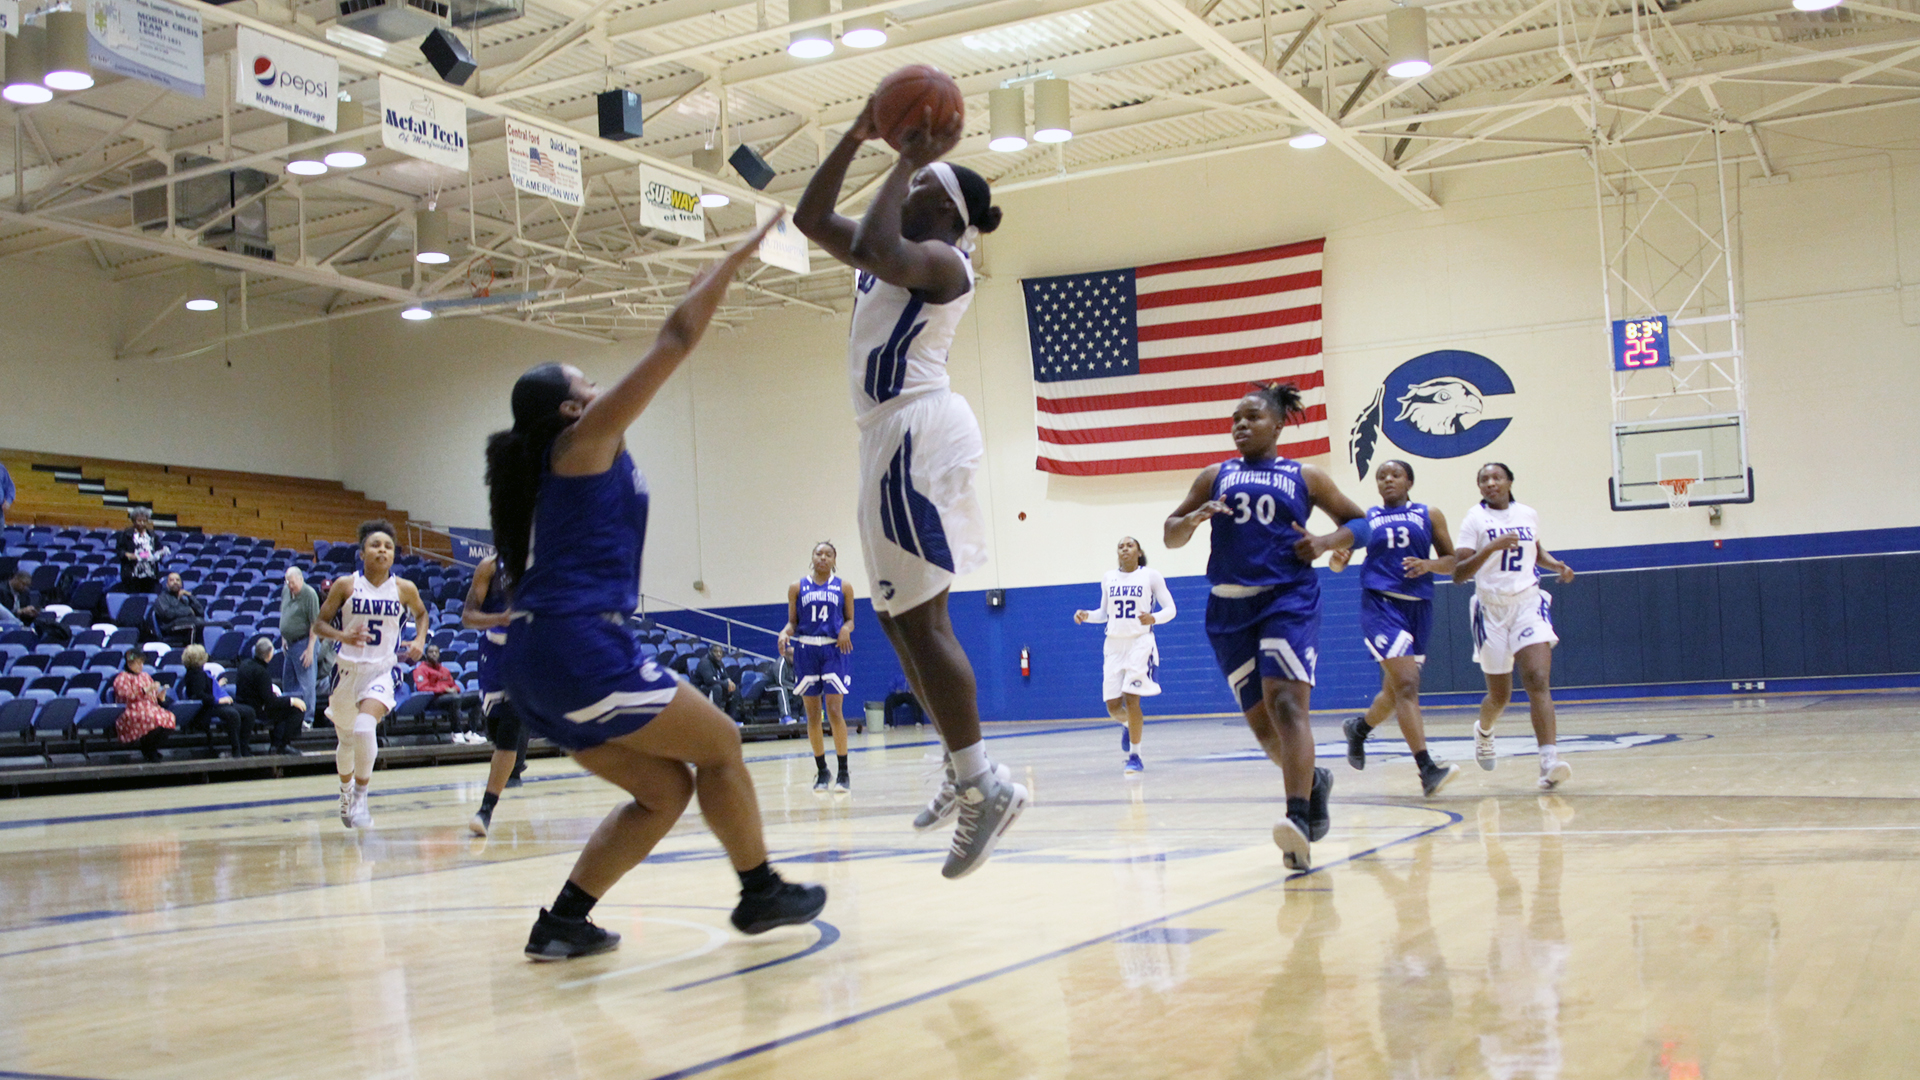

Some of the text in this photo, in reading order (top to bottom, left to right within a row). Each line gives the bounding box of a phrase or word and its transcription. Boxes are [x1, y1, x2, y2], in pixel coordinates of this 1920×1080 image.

[138, 12, 169, 27] MOBILE
[172, 22, 198, 38] CRISIS
[139, 20, 162, 32] TEAM
[280, 71, 327, 98] pepsi
[256, 92, 325, 123] McPherson Beverage
[386, 108, 463, 148] Metal Tech
[508, 124, 540, 145] Central Ford
[550, 138, 577, 157] Quick Lane
[512, 173, 579, 202] THE AMERICAN WAY
[645, 181, 700, 213] SUBWAY
[679, 213, 702, 221] fresh
[1625, 321, 1663, 339] 8:34
[1624, 337, 1659, 367] 25
[1273, 473, 1296, 499] STATE
[1234, 492, 1276, 525] 30
[1385, 526, 1410, 549] 13
[1501, 546, 1523, 571] 12
[1110, 585, 1143, 598] HAWKS
[352, 597, 400, 617] HAWKS
[811, 605, 829, 622] 14
[1114, 600, 1136, 619] 32
[366, 619, 383, 646] 5
